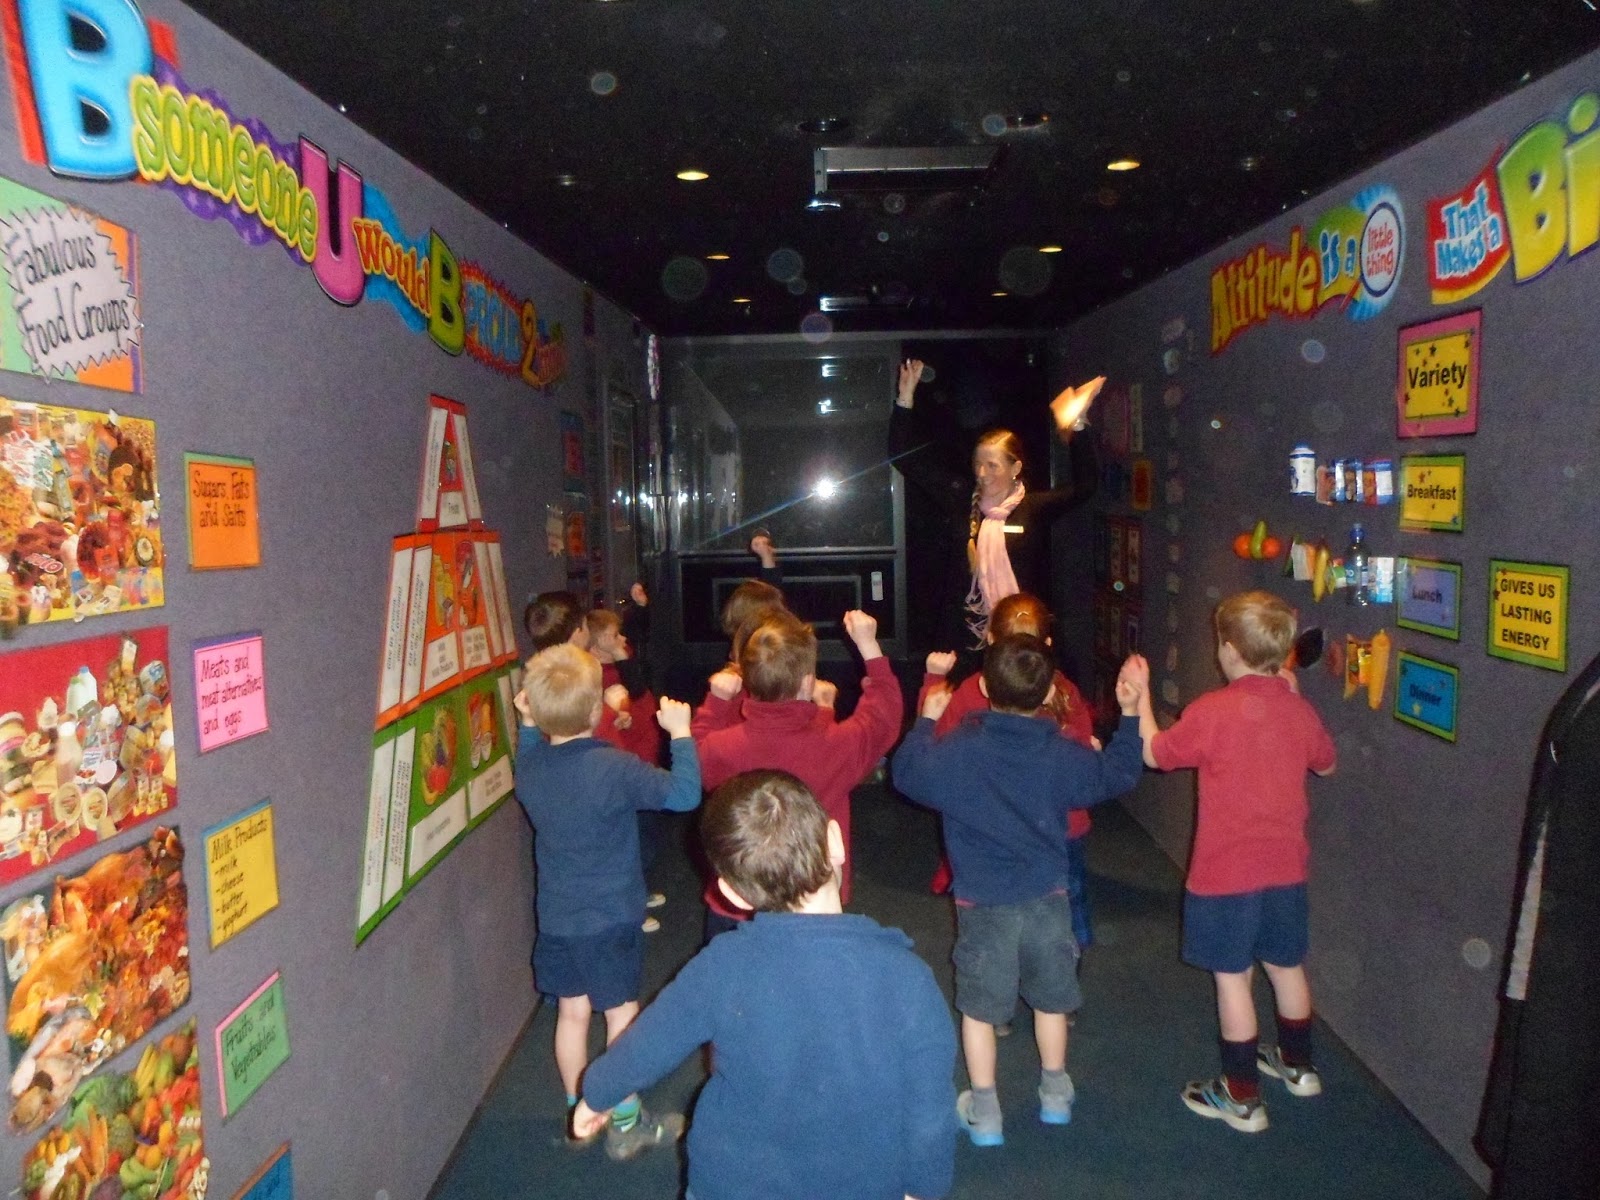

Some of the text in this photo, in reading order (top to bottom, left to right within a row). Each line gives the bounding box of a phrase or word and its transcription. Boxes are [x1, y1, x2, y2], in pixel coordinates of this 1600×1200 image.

[20, 0, 154, 180] B
[300, 133, 363, 307] U
[427, 227, 466, 357] B
[1442, 179, 1490, 241] That
[1367, 222, 1394, 253] little
[5, 222, 97, 293] Fabulous
[1366, 248, 1394, 277] thing
[1435, 227, 1486, 279] Makes
[1210, 228, 1319, 353] Attitude
[18, 282, 131, 356] Food Groups
[1408, 361, 1468, 390] Variety
[1407, 484, 1457, 501] Breakfast
[200, 502, 219, 528] and
[1412, 588, 1443, 604] Lunch
[1500, 578, 1556, 599] GIVES US
[1501, 603, 1552, 625] LASTING
[1501, 628, 1550, 651] ENERGY
[200, 646, 250, 682] Meats and
[1409, 683, 1443, 707] Dinner
[203, 707, 219, 735] and
[211, 834, 233, 864] Milk
